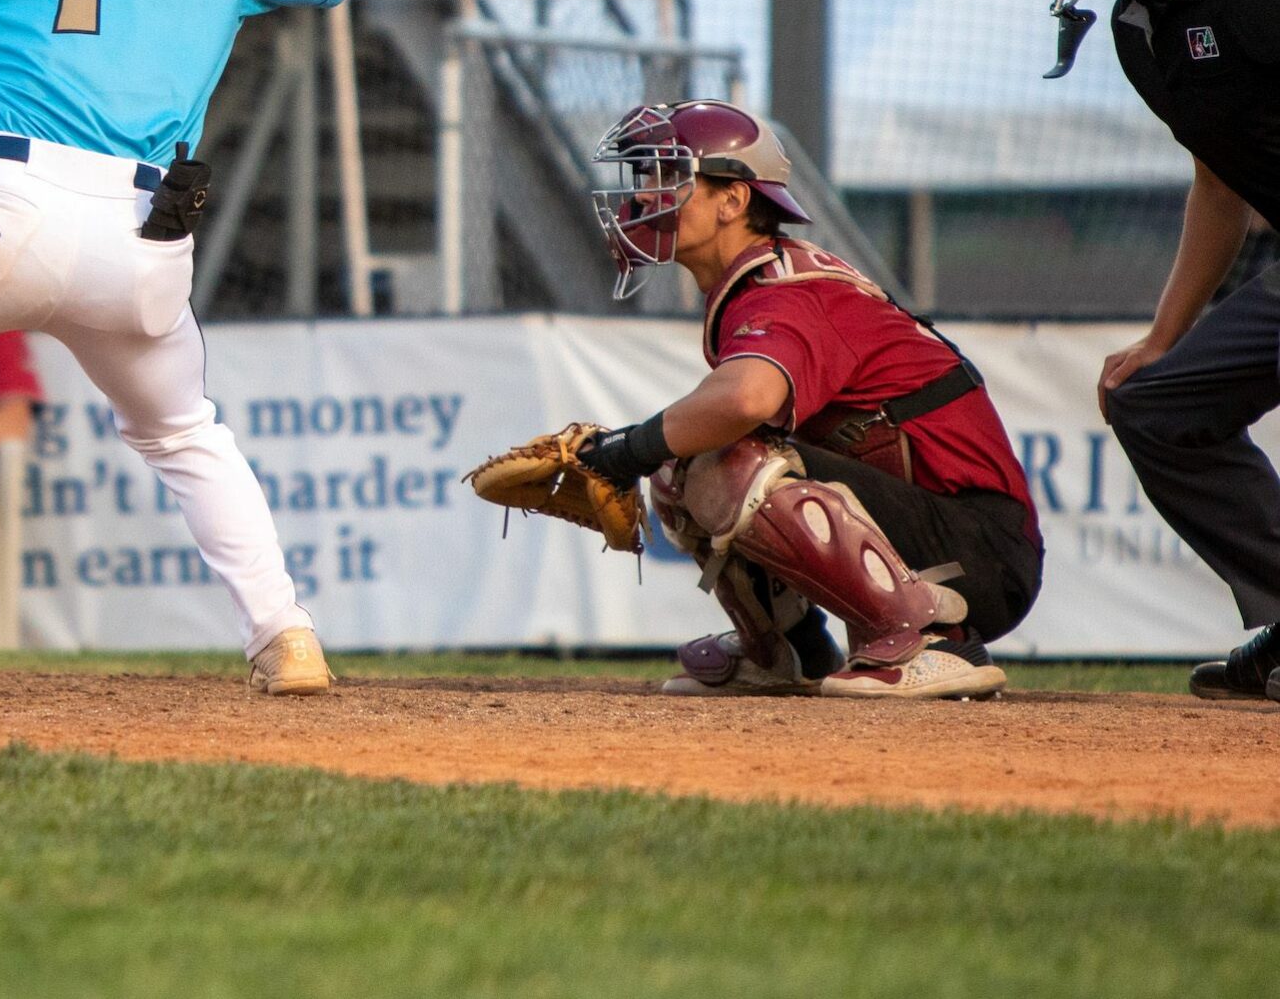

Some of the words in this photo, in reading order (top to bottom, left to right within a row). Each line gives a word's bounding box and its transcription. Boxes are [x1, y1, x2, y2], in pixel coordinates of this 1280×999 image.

[248, 394, 462, 449] money
[1019, 431, 1143, 514] RI
[77, 546, 318, 597] earng
[338, 524, 376, 581] it
